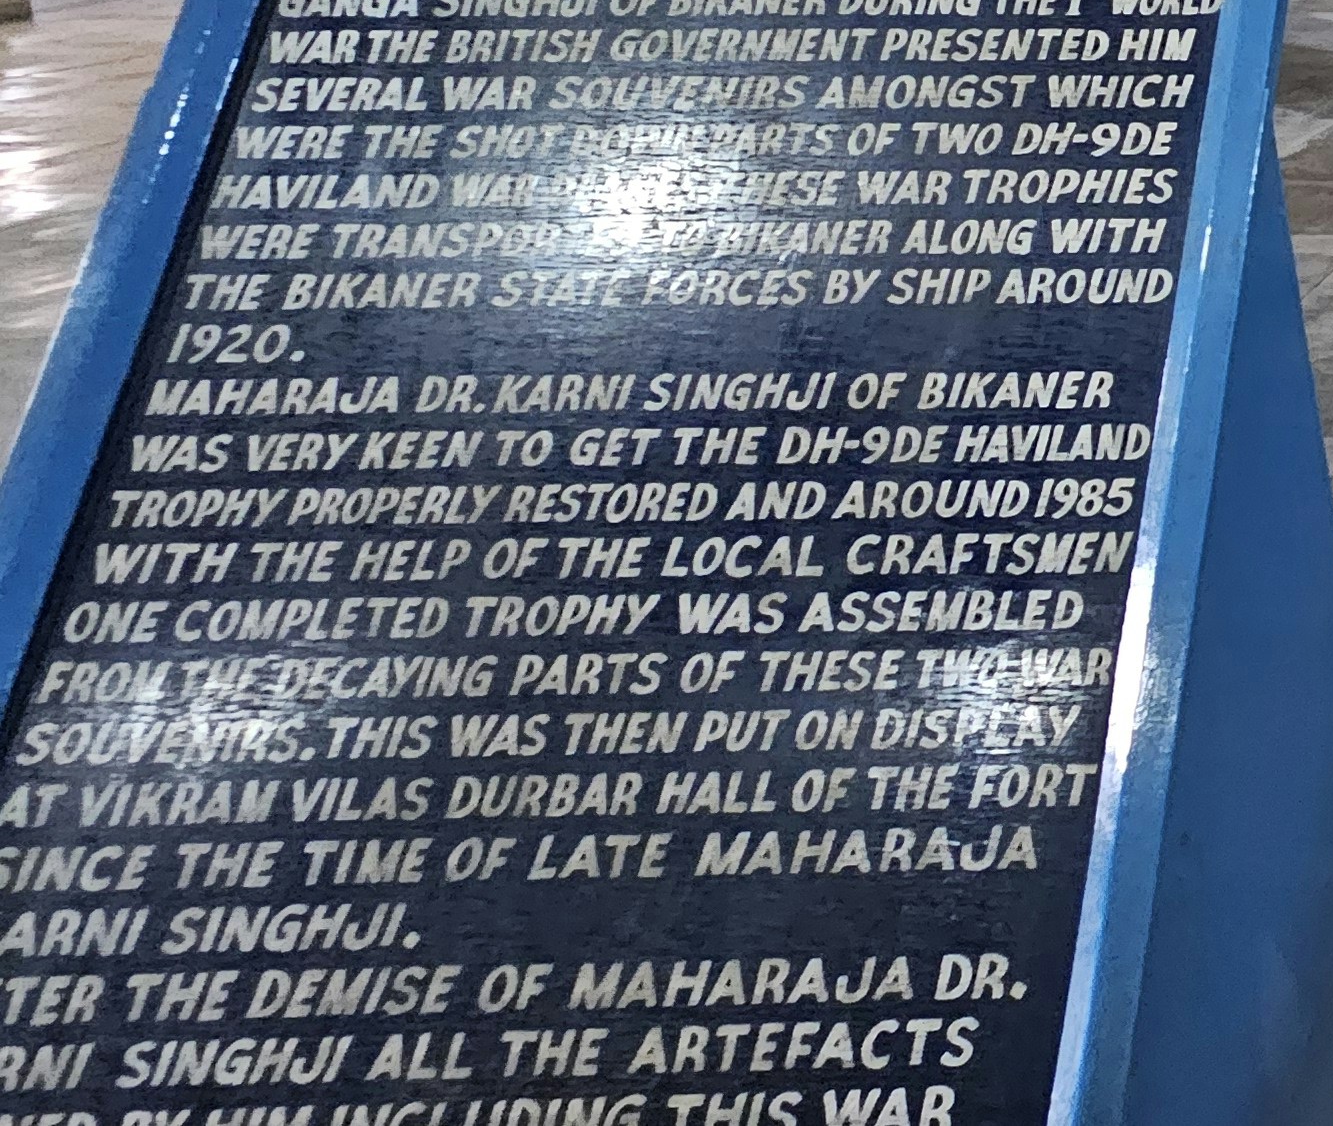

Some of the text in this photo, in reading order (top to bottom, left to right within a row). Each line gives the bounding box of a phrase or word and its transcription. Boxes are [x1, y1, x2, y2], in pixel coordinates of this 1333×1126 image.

[270, 28, 1196, 65] WAR THE BRITISH GOVERNMENT PRESENTED HIM
[251, 74, 1194, 112] SEVERAL WAR SOUVENIRS AMONGST WHICH
[234, 125, 353, 159] WERE
[365, 125, 444, 159] THE
[450, 123, 565, 159] SHOT
[847, 123, 901, 156] OF
[912, 122, 1003, 155] TWO
[1012, 122, 1177, 156] DH-9DE
[212, 174, 440, 209] HAVILAND
[453, 173, 544, 209] WAR
[857, 171, 952, 204] WAR
[963, 168, 1177, 204] TROPHIES
[202, 223, 320, 259] WERE
[901, 219, 1037, 255] ALONG
[1051, 218, 1167, 253] WITH
[186, 268, 1173, 310] THE BIKANER STATE FORCES BY SHIP AROUND
[168, 324, 305, 363] 1920.
[146, 371, 1113, 415] MAHARAJA DR. KARNI SINGHJI OF BIKANER
[132, 424, 1151, 473] WAS VERY KEEN TO GET THE DH-9DE HAVILAND
[112, 478, 1135, 527] TROPHY PROPERLY RESTORED AND AROUND 1985
[96, 532, 1133, 584] WITH THE HELP OF THE LOCAL CRAFTSMEN
[64, 587, 1084, 644] ONE COMPLETED TROPHY WAS ASSEMBLED
[37, 660, 172, 705] FROM
[281, 656, 497, 701] DECAYING
[509, 653, 668, 695] PARTS
[680, 651, 745, 693] OF
[760, 650, 905, 692] THESE
[13, 705, 1078, 766] SOUVENIRS. THIS WAS THEN PUT ON DISPLAY
[0, 762, 1097, 827] AT VIKRAM VILAS DURBAR HALL OF THE FORT
[178, 841, 284, 888] THE
[304, 838, 432, 885] TIME
[446, 837, 516, 881] OF
[528, 833, 672, 880] LATE
[695, 825, 1037, 875] MAHARAJA
[0, 903, 420, 957] ARNI SINGHJI.
[127, 970, 239, 1021] THE
[246, 965, 462, 1018] DEMISE
[478, 964, 553, 1013] OF
[569, 956, 913, 1009] MAHARAJA
[935, 953, 1027, 1000] DR.
[116, 1036, 353, 1088] SINGHJI
[365, 1032, 471, 1080] ALL
[501, 1028, 609, 1076] THE
[628, 1017, 979, 1073] ARTEFACTS
[823, 1085, 955, 1126] WAR
